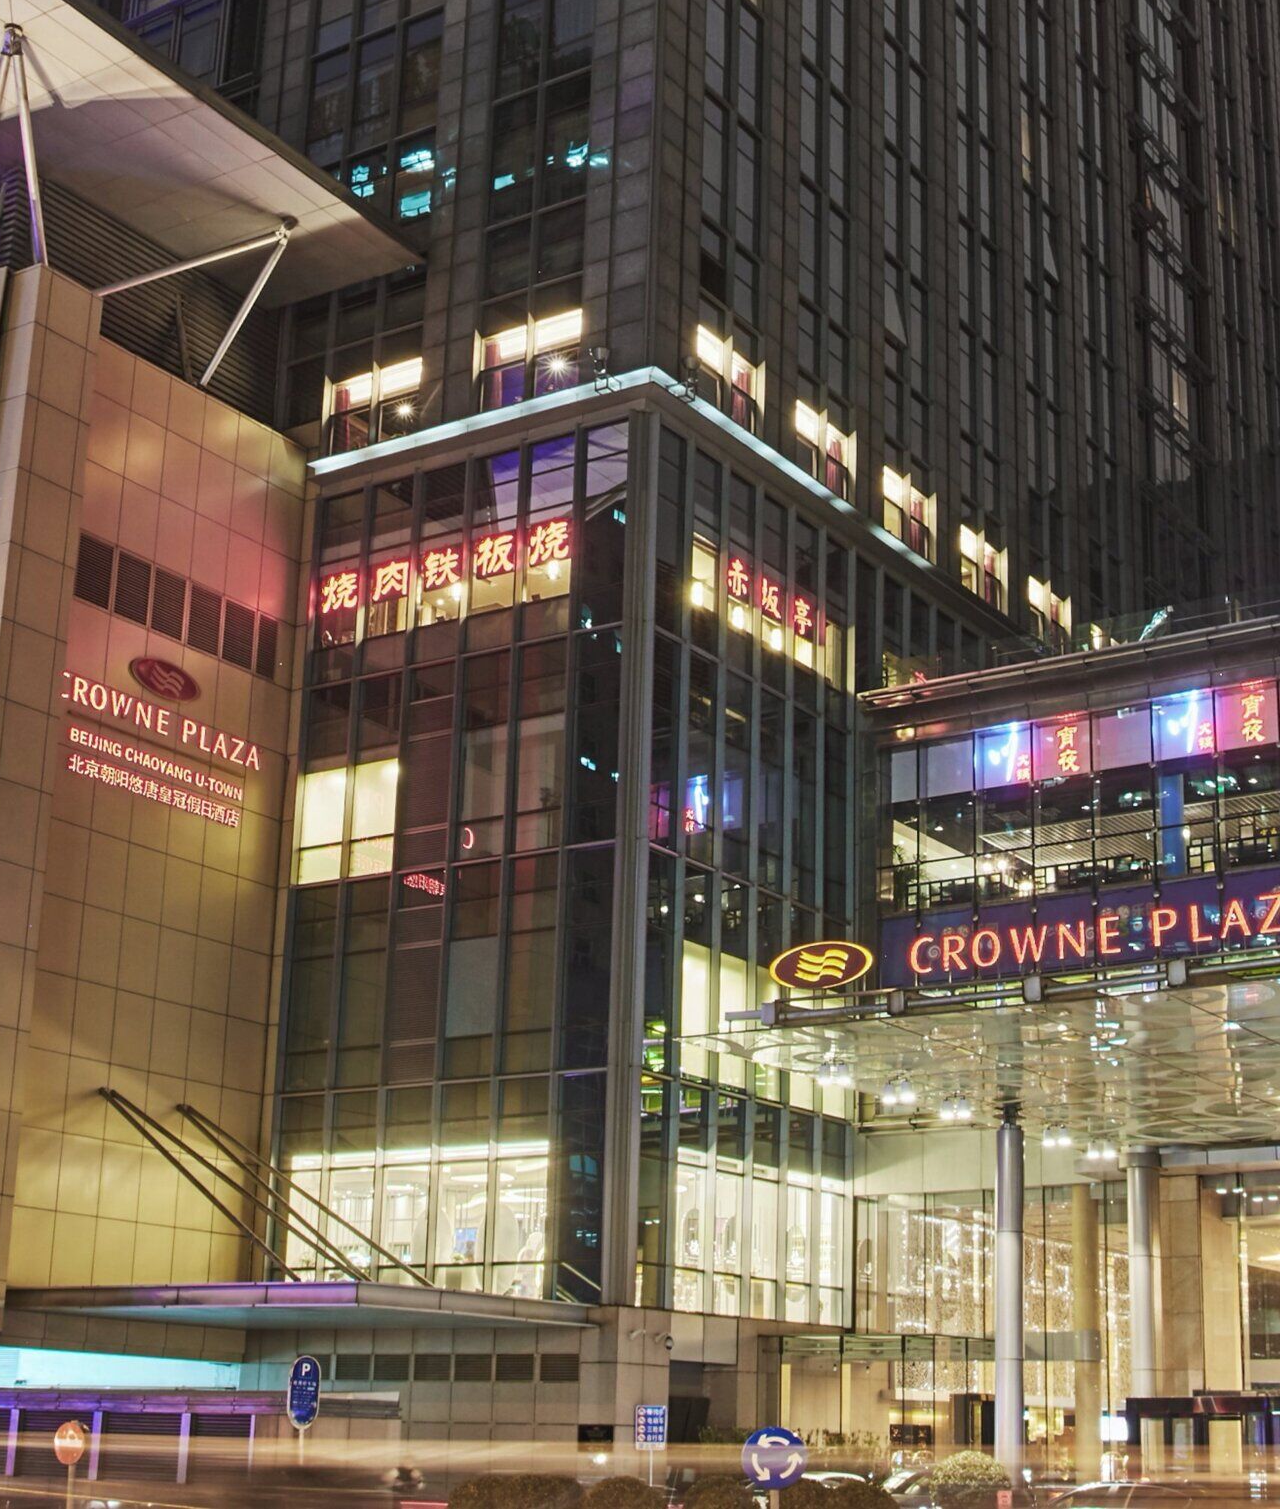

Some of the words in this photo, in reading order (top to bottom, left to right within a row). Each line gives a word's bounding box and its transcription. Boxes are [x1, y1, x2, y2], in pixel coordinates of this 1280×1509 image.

[321, 521, 569, 613] 烧肉铁板烧
[727, 559, 812, 635] 赤坂亭
[70, 728, 122, 757] BEIJING
[124, 748, 192, 783] CHAOYANG
[195, 773, 242, 801] U-TOWN
[182, 719, 260, 771] PLAZA
[68, 754, 240, 828] 北京朝阳悠唐皇冠假日酒店
[909, 915, 1119, 974] CROWNE
[302, 1363, 311, 1376] P
